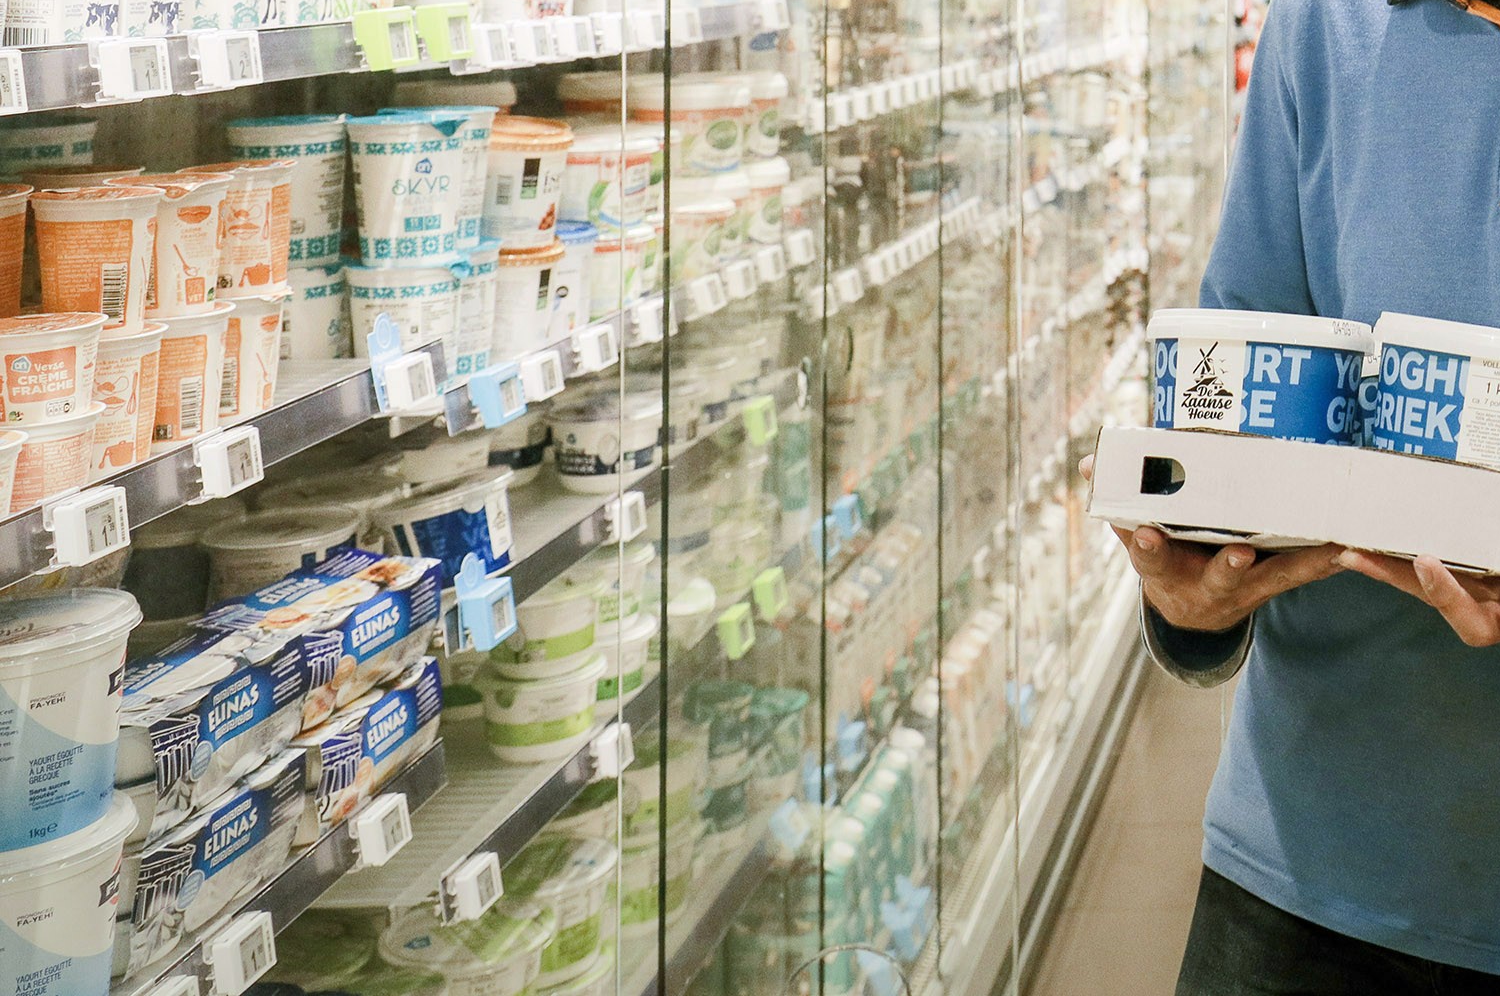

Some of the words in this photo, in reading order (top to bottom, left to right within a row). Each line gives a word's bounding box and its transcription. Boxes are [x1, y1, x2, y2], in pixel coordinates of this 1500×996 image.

[392, 175, 450, 196] SKYR
[34, 360, 65, 372] Verse
[17, 369, 69, 386] CRÈME
[1198, 386, 1213, 397] De
[1181, 392, 1233, 409] Zaanse
[1187, 408, 1224, 421] Hoeve
[351, 606, 400, 649] ELINAS
[30, 696, 66, 710] FA-YEH!
[207, 684, 259, 733] ELINAS
[366, 705, 408, 750] ELINAS
[29, 753, 56, 767] YAOURT
[36, 765, 45, 775] LA
[46, 757, 73, 772] RECETTE
[29, 769, 60, 785] GRECQUE
[29, 787, 47, 796] Sans
[49, 779, 71, 791] sucres
[204, 807, 258, 860] ELINAS
[16, 911, 54, 927] FA-YEH!
[16, 968, 43, 984] YAOURT
[33, 971, 62, 986] RECETTE
